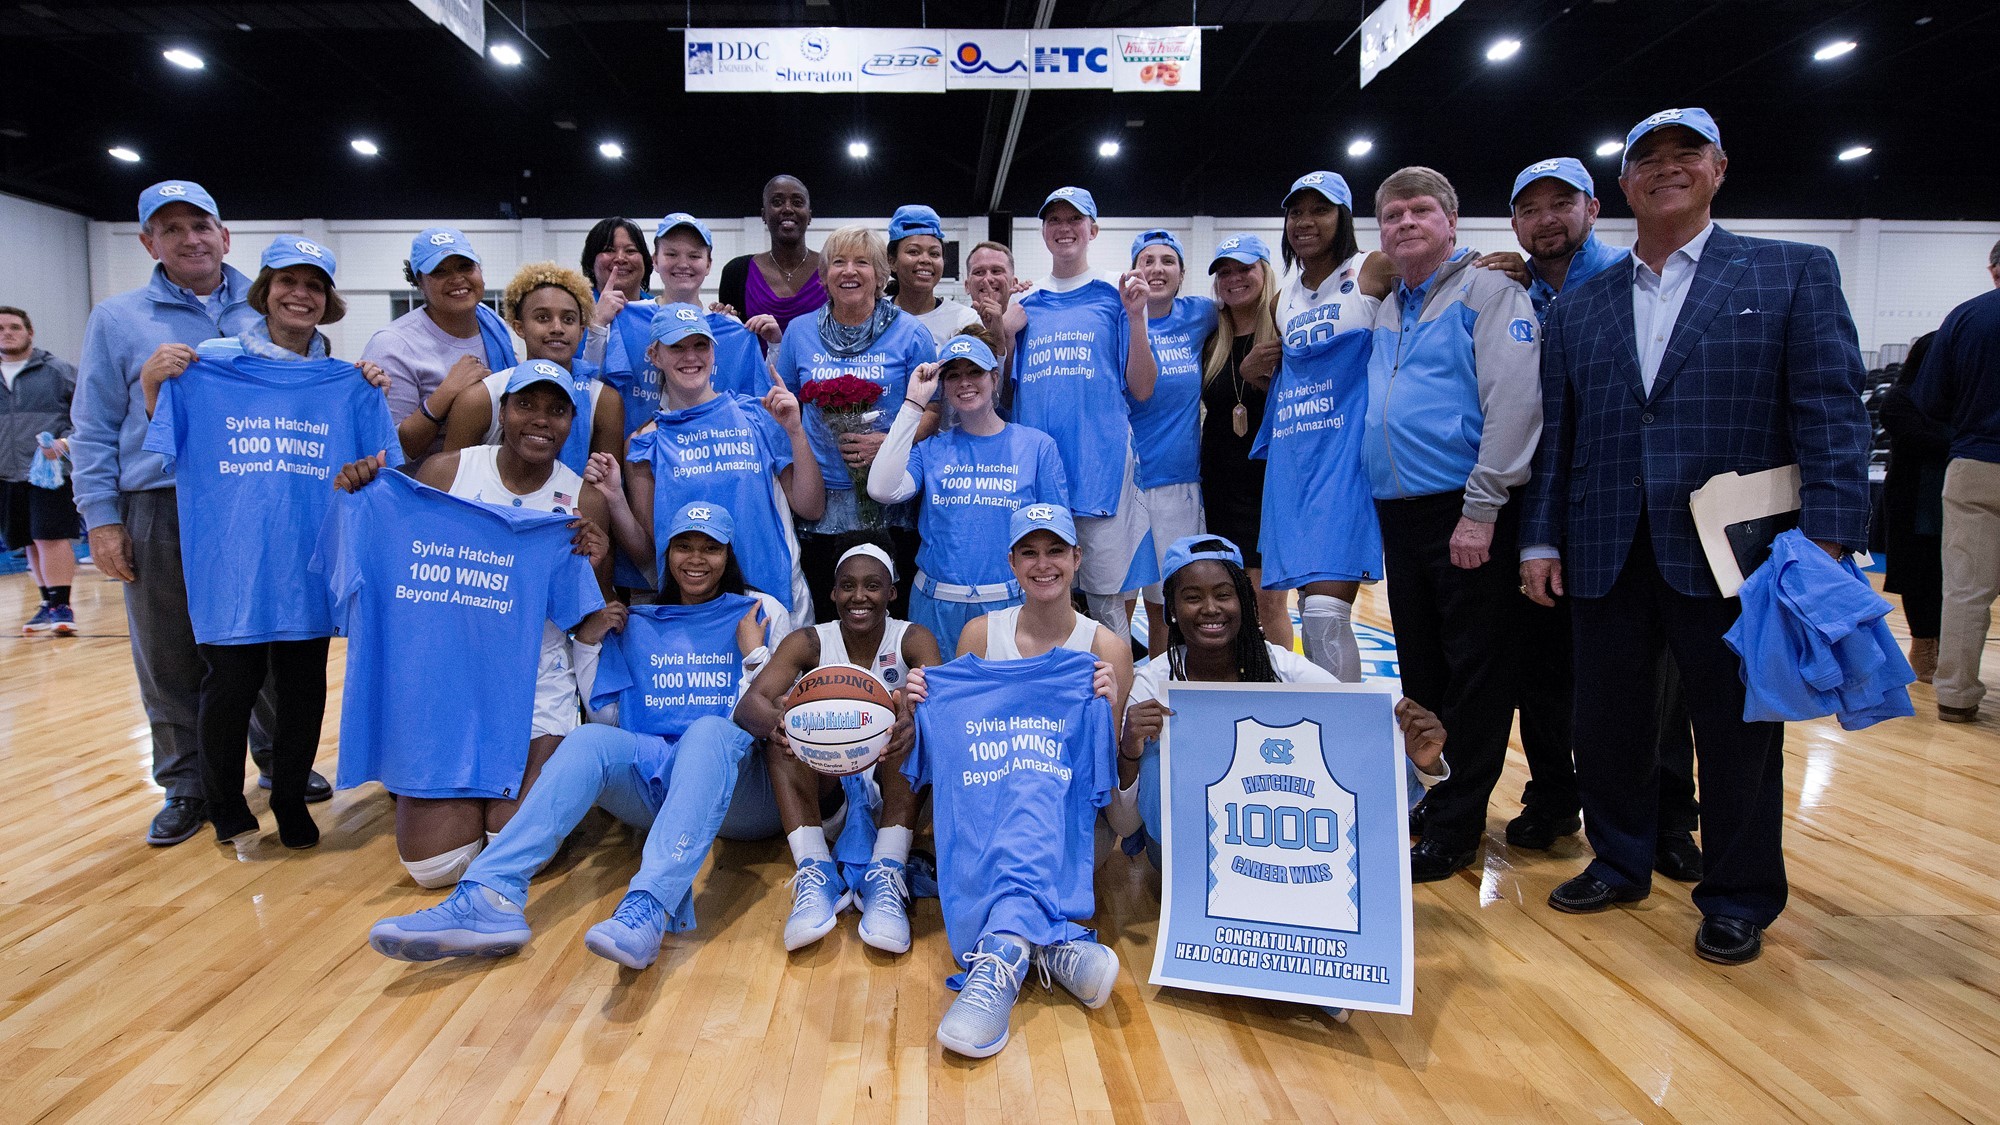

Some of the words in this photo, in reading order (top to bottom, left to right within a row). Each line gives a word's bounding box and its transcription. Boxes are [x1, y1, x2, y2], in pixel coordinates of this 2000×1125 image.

[717, 41, 770, 61] DDC
[870, 53, 943, 67] BBC
[1034, 47, 1108, 73] HTC
[775, 67, 853, 83] Sheraton
[1286, 303, 1341, 336] NORTH
[1028, 334, 1053, 350] Sylvia
[1054, 330, 1095, 343] Hatchell
[1153, 332, 1190, 345] Hatchell
[1027, 348, 1051, 367] 1000
[1053, 346, 1092, 361] WINS!
[1157, 346, 1193, 362] WINS!
[811, 366, 840, 380] 1000
[844, 365, 885, 380] WINS!
[1022, 365, 1052, 383] Beyond
[1053, 364, 1095, 380] Amazing!
[1294, 379, 1333, 397] Hatchell
[1294, 396, 1335, 417] WINS!
[225, 416, 271, 433] Sylvia
[274, 416, 330, 436] Hatchell
[1295, 414, 1345, 433] Amazing!
[676, 429, 709, 446] Sylvia
[710, 427, 753, 438] Hatchell
[228, 436, 272, 454] 1000
[275, 437, 326, 459] WINS!
[678, 445, 710, 462] 1000
[713, 441, 755, 457] WINS!
[219, 459, 273, 476] Beyond
[275, 459, 330, 480] Amazing!
[673, 462, 713, 478] Beyond
[715, 459, 763, 474] Amazing!
[943, 463, 974, 475] Sylvia
[976, 463, 1019, 475] Hatchell
[940, 477, 972, 490] 1000
[975, 477, 1017, 493] WINS!
[932, 493, 971, 508] Beyond
[972, 493, 1022, 511] Amazing!
[411, 539, 455, 558] Sylvia
[458, 545, 515, 568] Hatchell
[409, 562, 451, 583] 1000
[456, 567, 509, 592] WINS!
[395, 585, 449, 604] Beyond
[450, 590, 514, 615] Amazing!
[650, 653, 684, 669] Sylvia
[687, 652, 733, 665] Hatchell
[652, 672, 683, 689] 1000
[687, 671, 731, 688] WINS!
[797, 674, 875, 698] SPALDING
[645, 693, 685, 709] Beyond
[802, 711, 826, 736] Sylvia
[826, 710, 862, 730] Hatchell
[965, 718, 1007, 737] Sylvia
[1009, 716, 1066, 734] Hatchell
[968, 740, 1008, 762] 1000
[1011, 734, 1063, 761] WINS!
[962, 761, 1010, 787] Beyond
[1011, 757, 1073, 782] Amazing!
[1241, 774, 1315, 799] HATCHELL
[1224, 802, 1339, 853] 1000
[1231, 855, 1289, 884] CAREER
[1289, 863, 1333, 884] WINS
[1215, 926, 1348, 958] CONGRATULATIONS
[1175, 942, 1211, 962] HEAD
[1212, 947, 1258, 969] COACH
[1260, 953, 1311, 976] SYLVIA
[1314, 960, 1390, 985] HATCHELL
